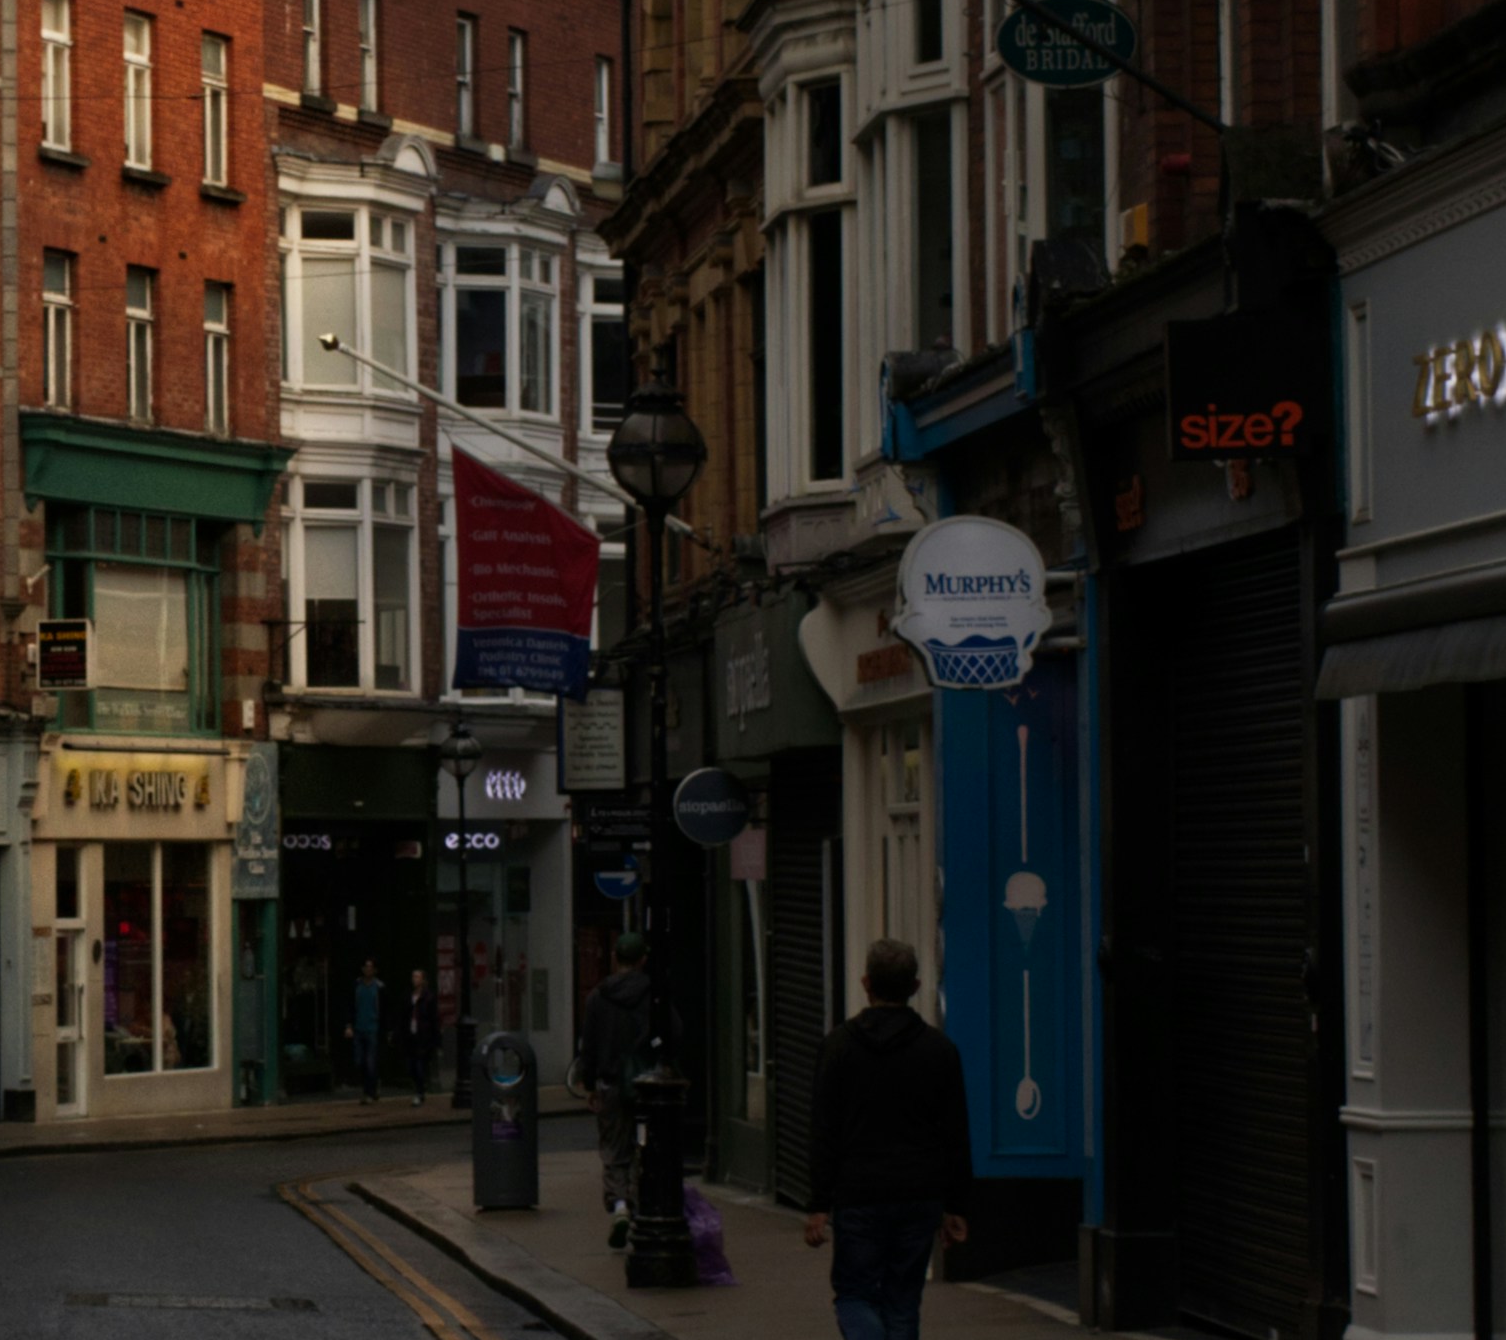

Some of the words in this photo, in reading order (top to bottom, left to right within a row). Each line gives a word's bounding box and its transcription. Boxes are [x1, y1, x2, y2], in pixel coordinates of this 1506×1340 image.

[1014, 13, 1038, 48] de
[1025, 48, 1110, 71] BRIDAL
[1179, 400, 1304, 450] size?
[472, 529, 498, 542] Gait
[503, 530, 553, 545] Analysis
[923, 568, 1032, 595] MURPHY'S
[472, 589, 523, 605] Orthotic
[91, 770, 120, 808] KA
[128, 770, 188, 809] SHING
